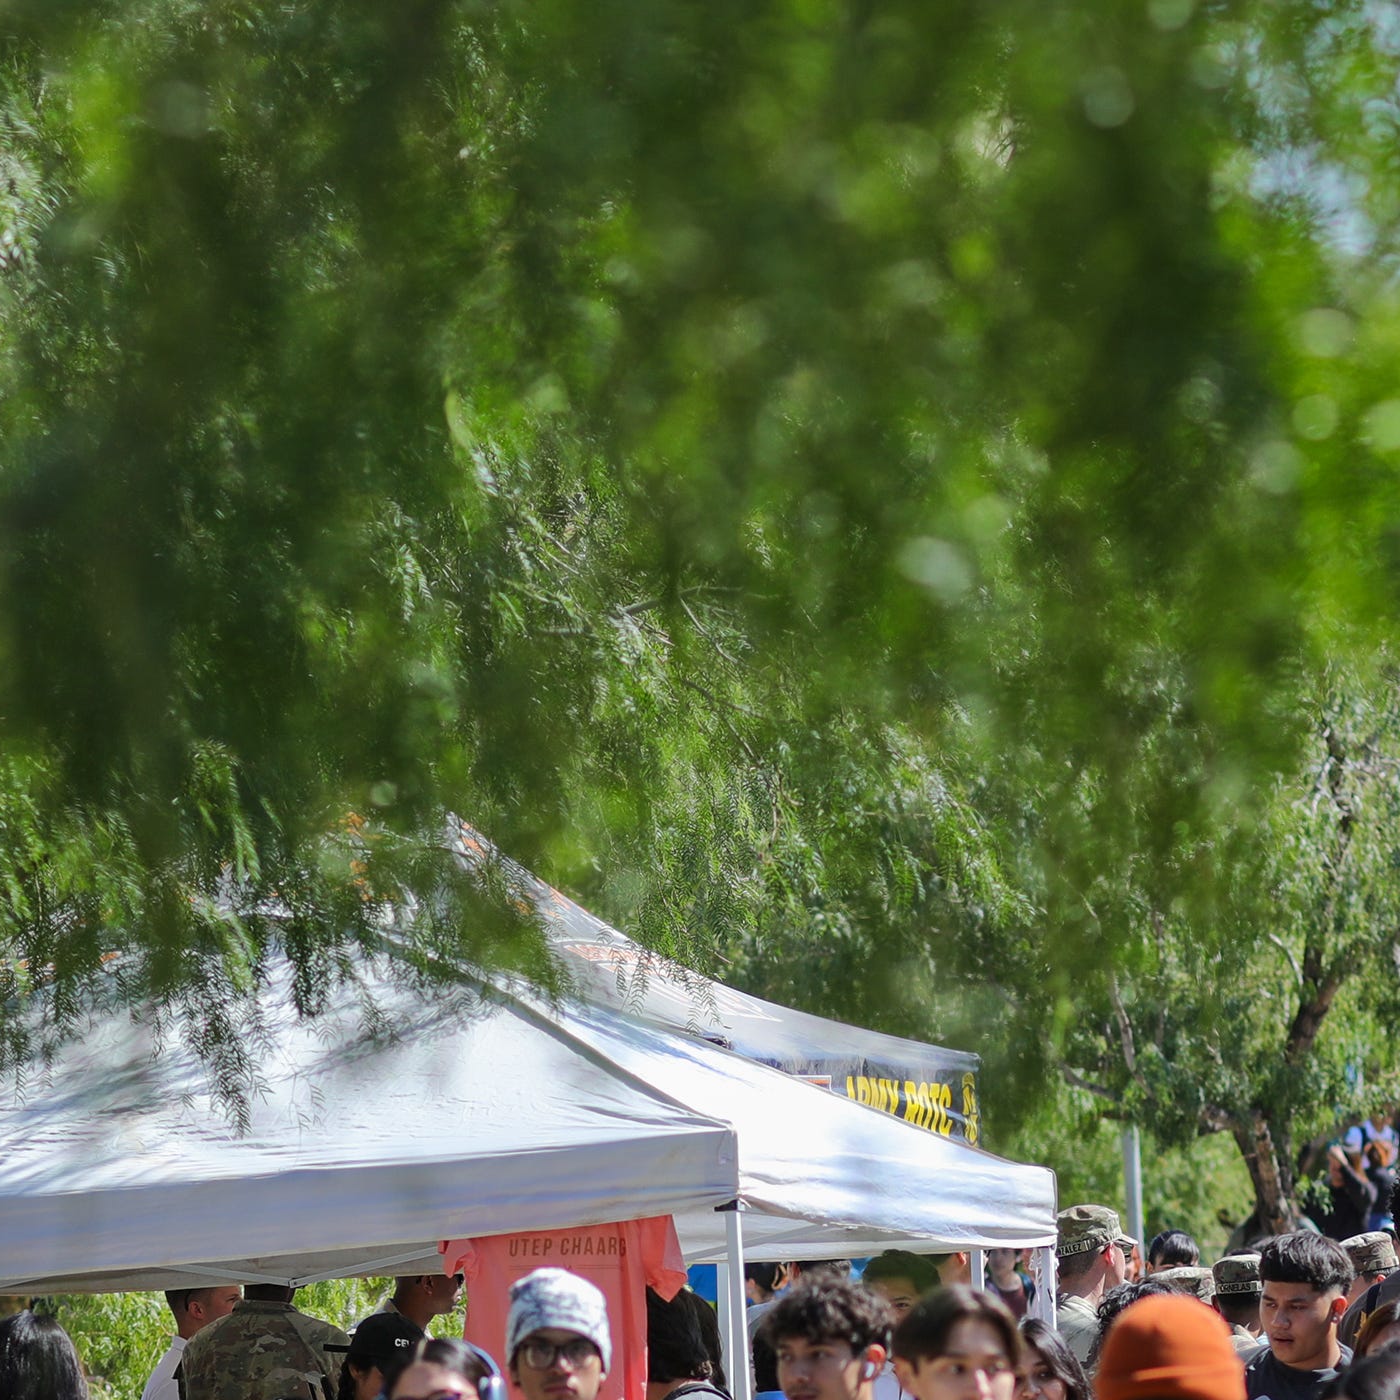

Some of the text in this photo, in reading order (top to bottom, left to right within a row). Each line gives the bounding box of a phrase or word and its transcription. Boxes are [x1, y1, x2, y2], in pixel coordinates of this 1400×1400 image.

[904, 1080, 954, 1138] ROTC
[509, 1236, 627, 1257] UTEP CHAARG
[1059, 1243, 1083, 1256] ZALEZ
